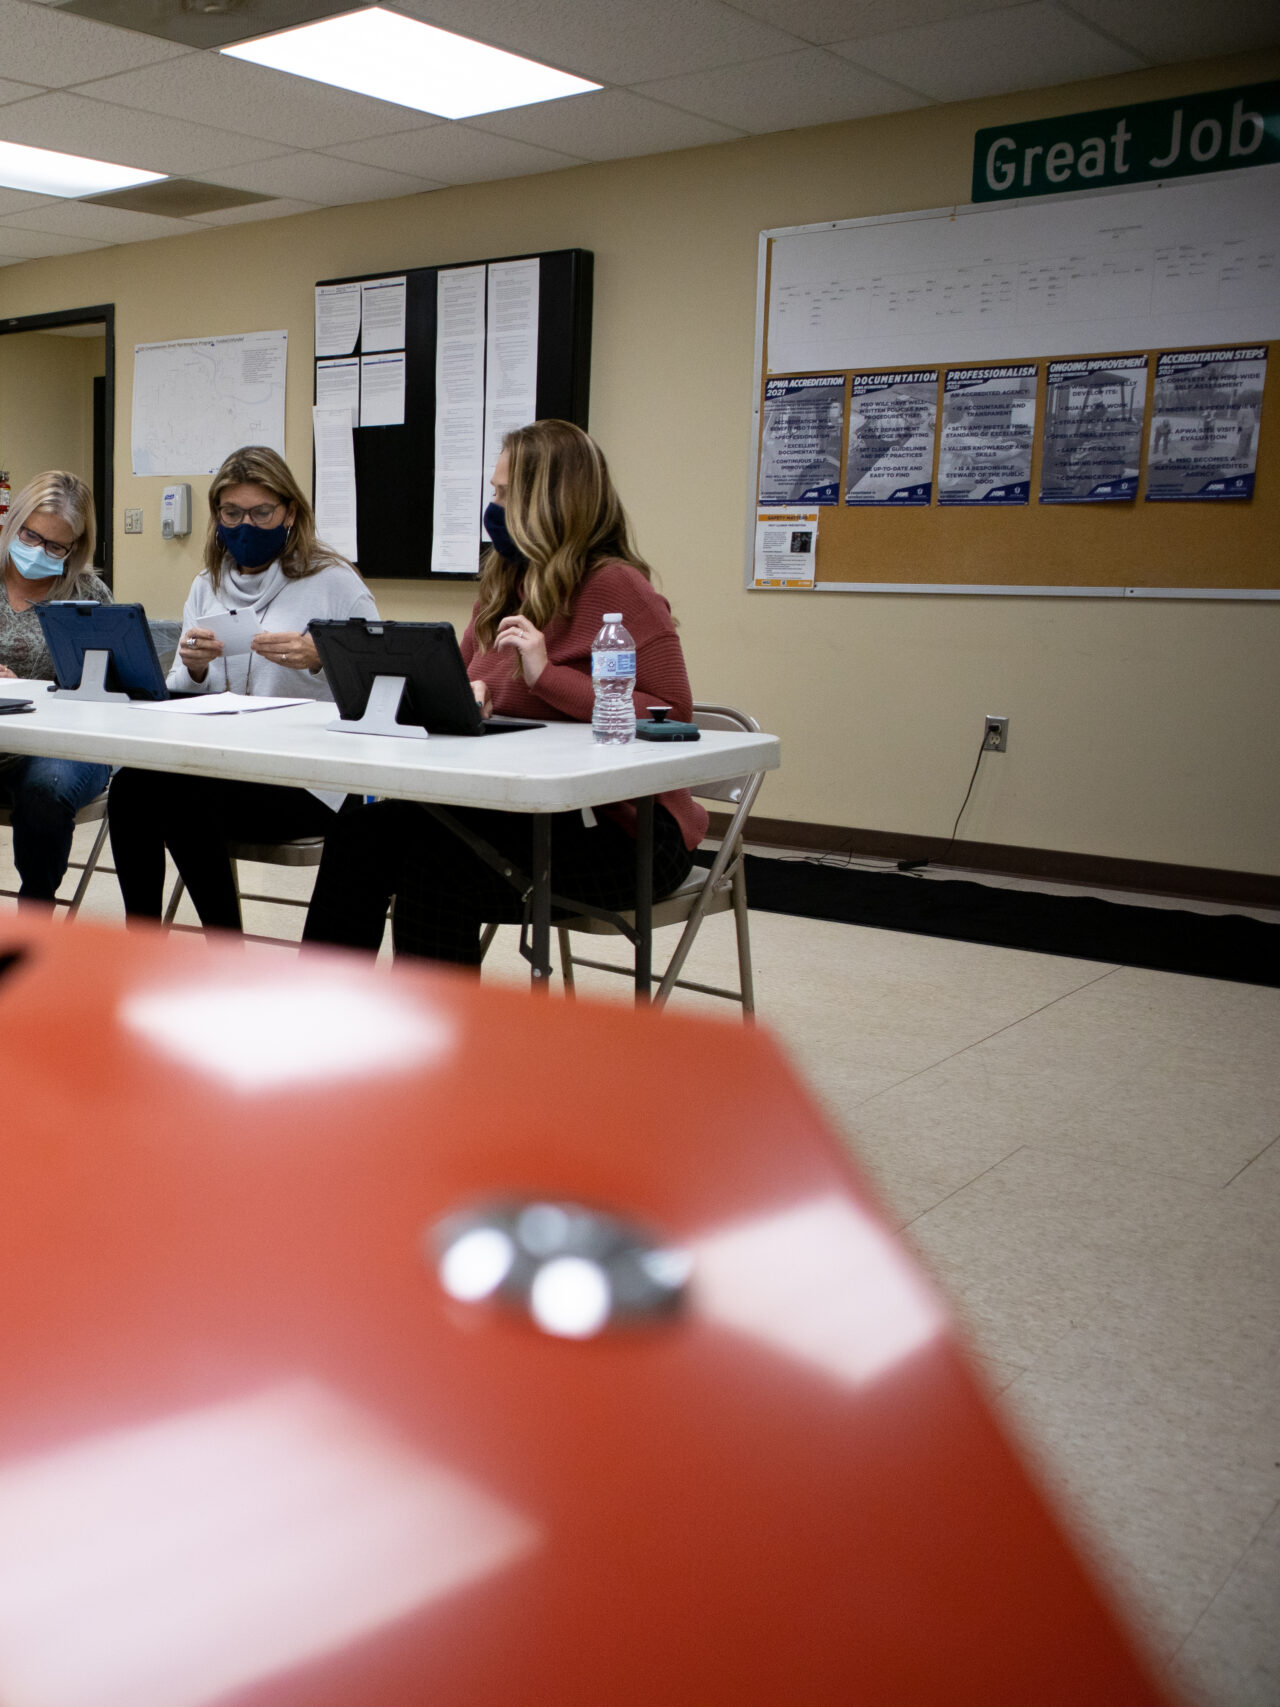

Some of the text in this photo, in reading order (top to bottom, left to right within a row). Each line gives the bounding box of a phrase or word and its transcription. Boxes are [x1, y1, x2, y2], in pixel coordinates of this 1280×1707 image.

[986, 98, 1265, 191] Great Job
[1160, 349, 1265, 364] ACCREDITATION STEPS
[1050, 357, 1146, 373] ONGOING IMPROVEMENT
[854, 373, 938, 385] DOCUMENTATION
[947, 366, 1037, 380] PROFESSIONALISM
[767, 377, 844, 389] APWA ACCREDITATION
[766, 389, 786, 397] 2021
